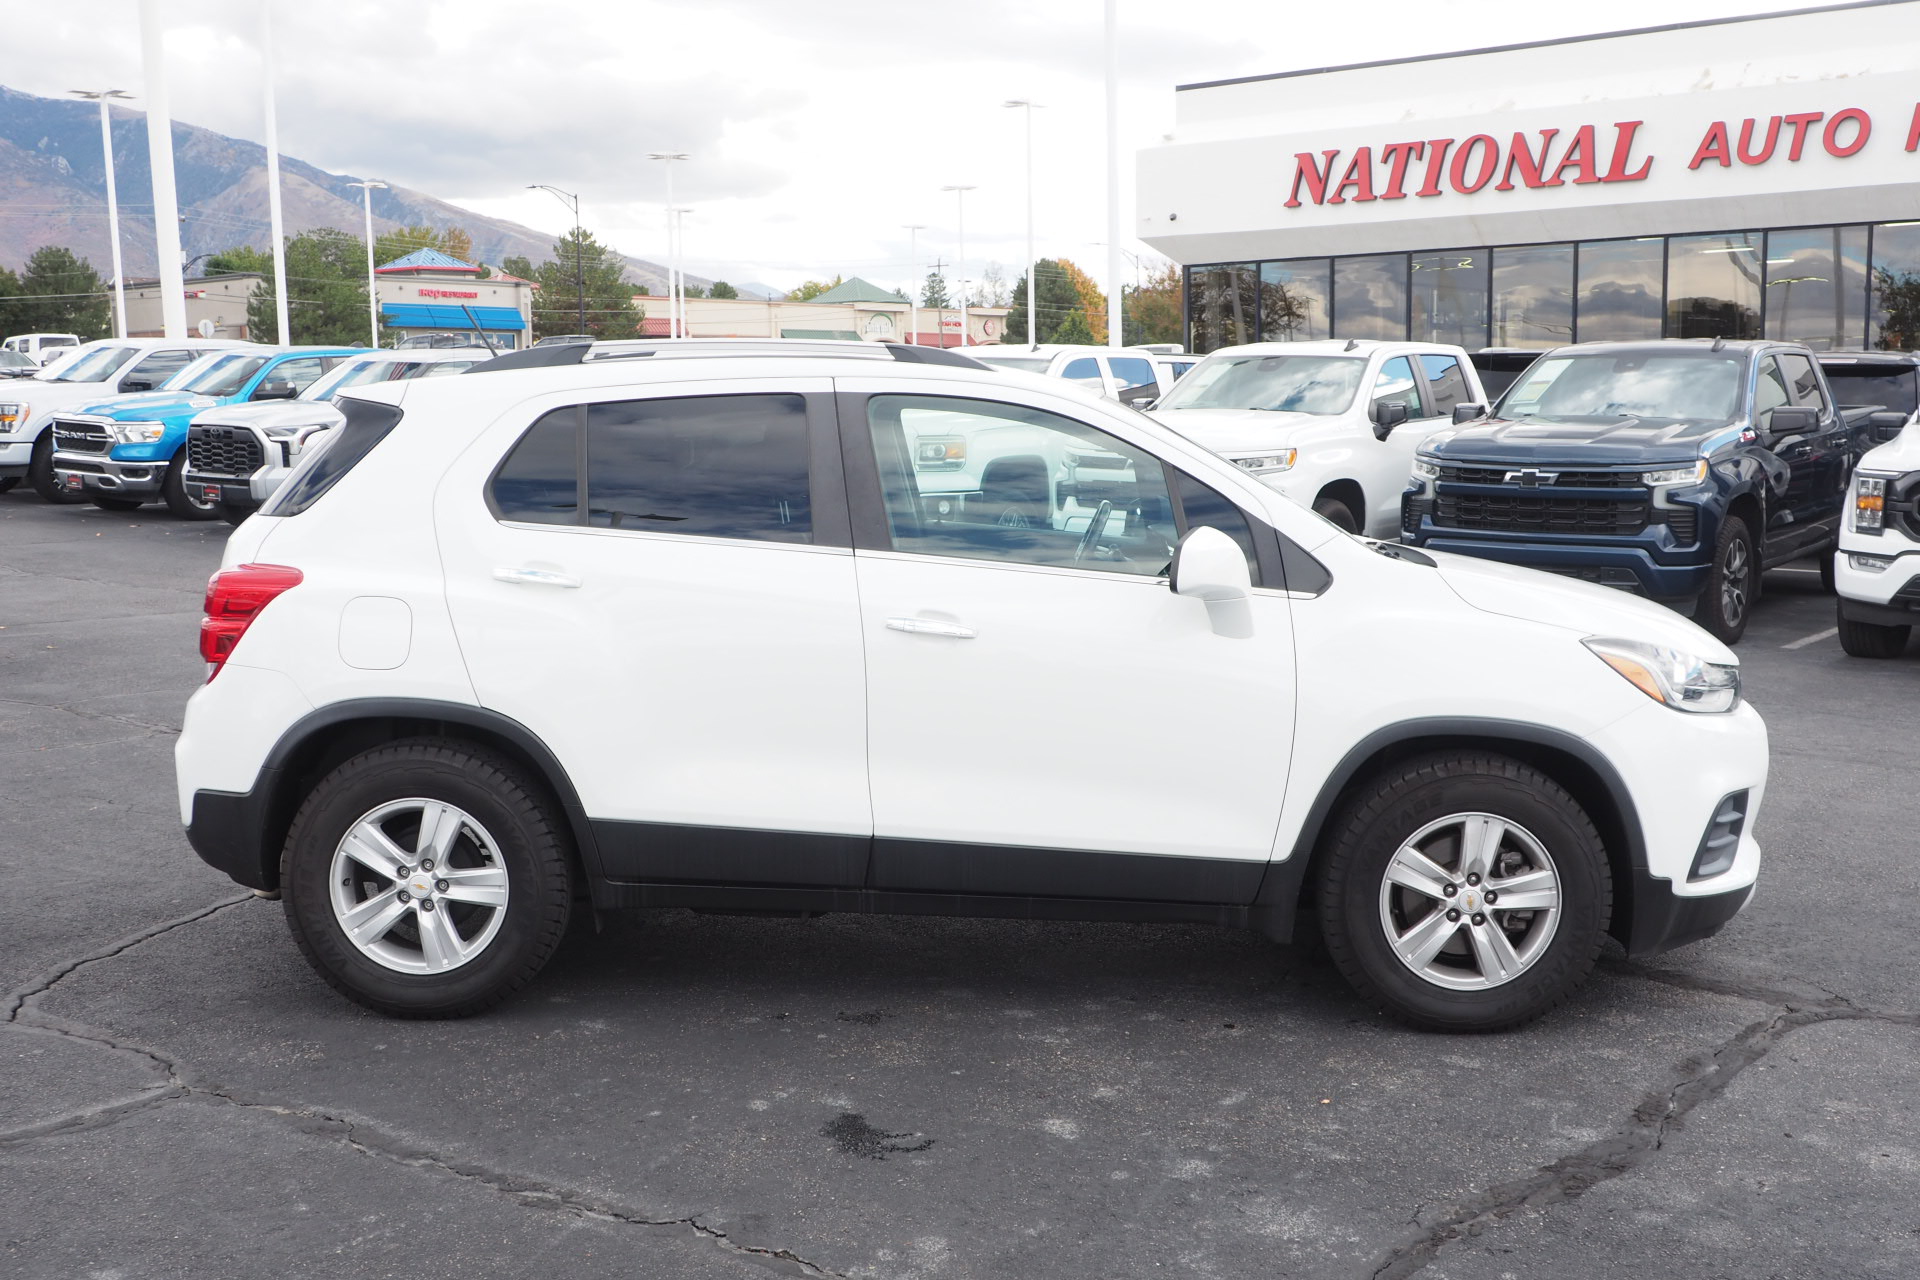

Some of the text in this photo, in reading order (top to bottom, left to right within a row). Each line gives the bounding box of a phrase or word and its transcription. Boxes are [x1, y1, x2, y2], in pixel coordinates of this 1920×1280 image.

[1284, 120, 1653, 207] NATIONAL
[1688, 107, 1872, 169] AUTO
[60, 430, 86, 440] RAM
